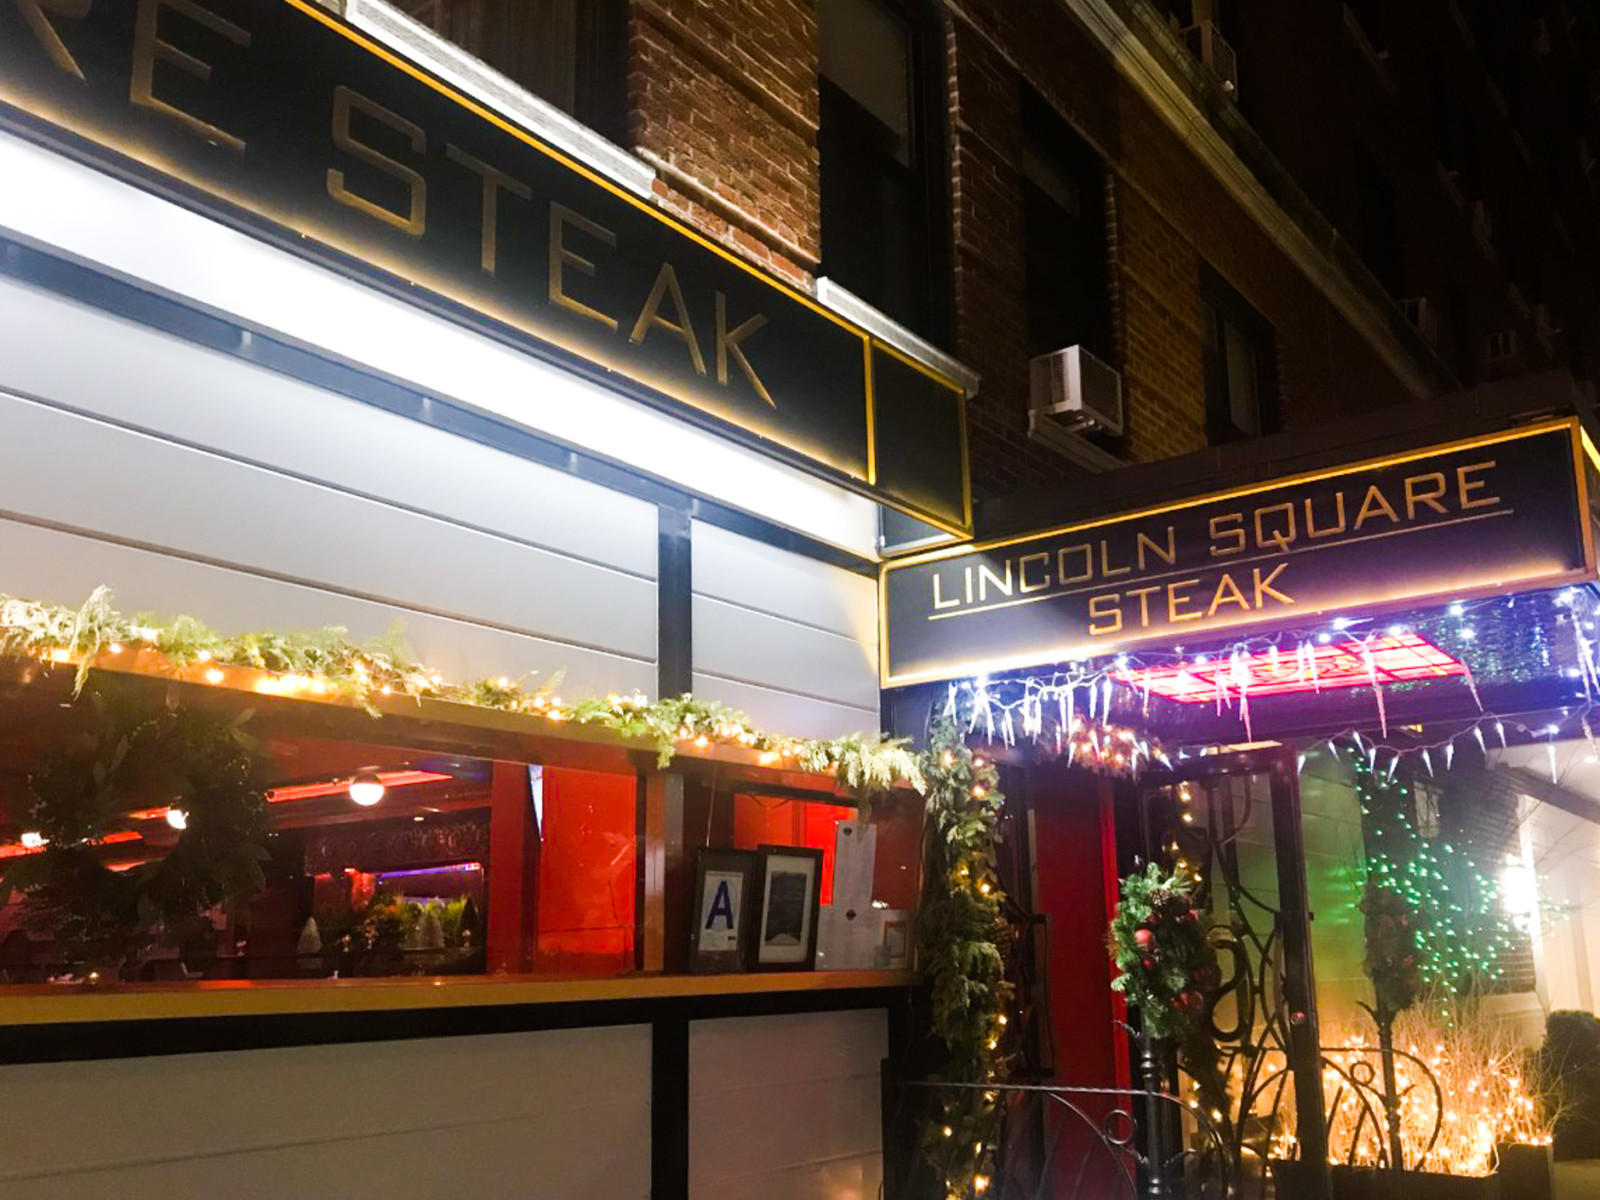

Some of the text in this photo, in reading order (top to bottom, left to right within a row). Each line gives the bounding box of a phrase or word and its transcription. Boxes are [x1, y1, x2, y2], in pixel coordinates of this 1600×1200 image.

[327, 85, 777, 408] STEAK
[933, 460, 1501, 609] LINCOLN SQUARE
[1088, 562, 1295, 635] STEAK
[704, 880, 734, 930] A
